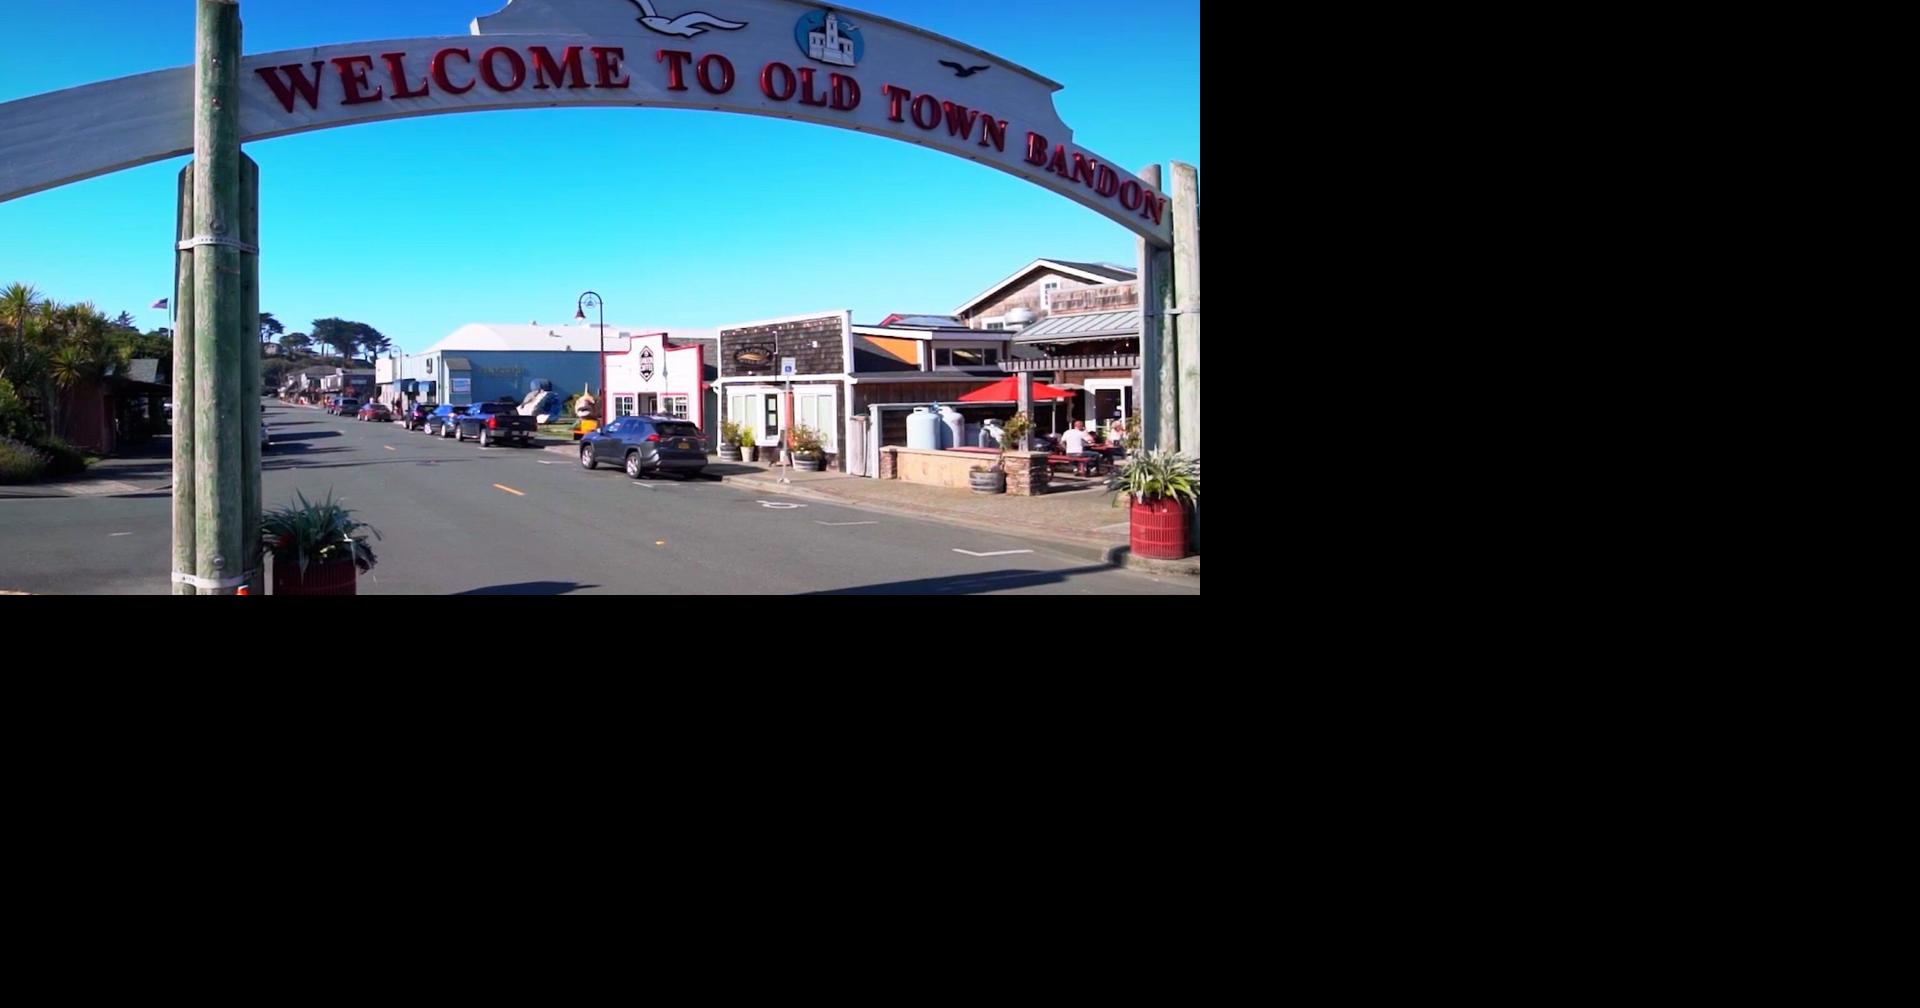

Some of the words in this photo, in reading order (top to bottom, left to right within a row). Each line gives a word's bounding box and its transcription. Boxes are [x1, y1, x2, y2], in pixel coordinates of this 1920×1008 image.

[255, 46, 630, 113] WELCOME
[657, 49, 735, 94] TO
[760, 62, 861, 111] OLD
[882, 83, 1009, 153] TOWN
[1024, 131, 1166, 226] BANDON
